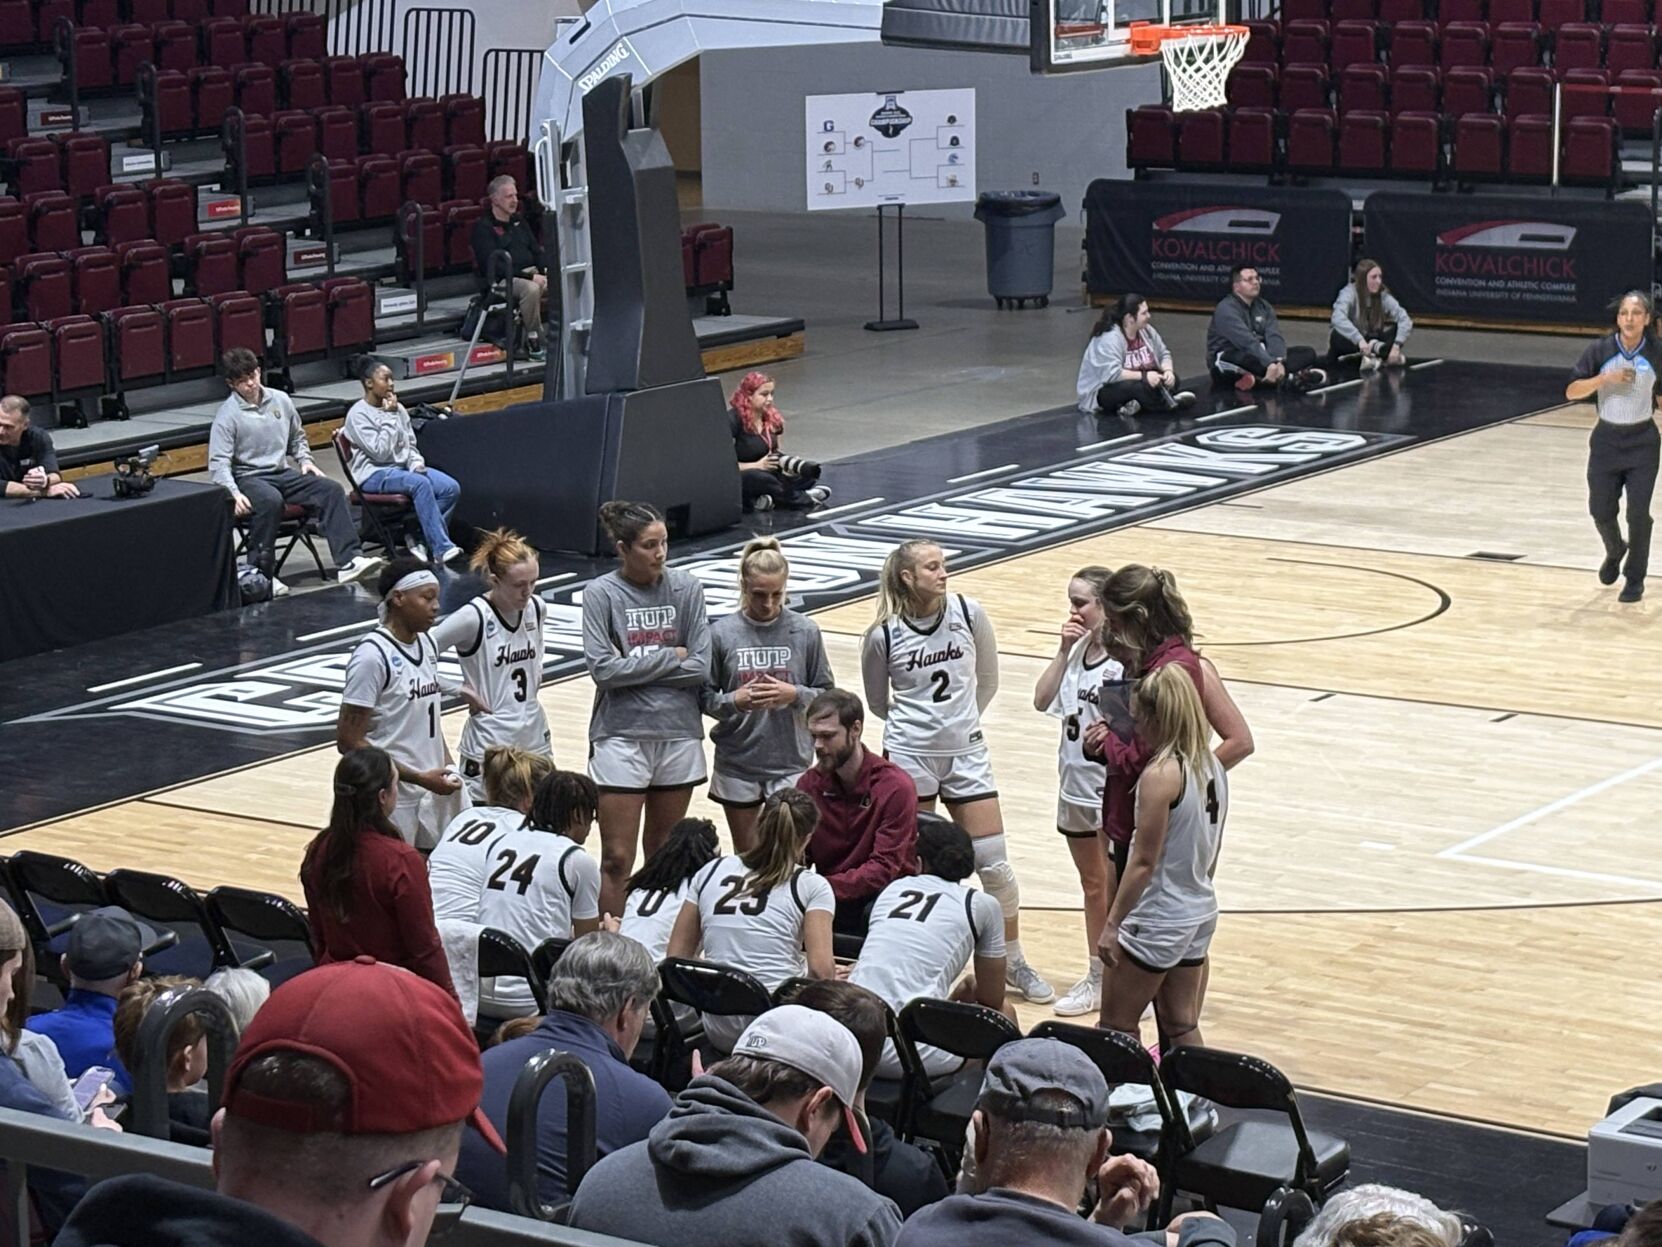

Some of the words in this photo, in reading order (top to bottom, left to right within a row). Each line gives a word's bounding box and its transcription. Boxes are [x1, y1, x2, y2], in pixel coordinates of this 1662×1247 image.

[578, 42, 630, 95] SPALDING
[1152, 238, 1281, 262] KOVALCHICK
[1435, 252, 1577, 278] KOVALCHICK
[1152, 261, 1198, 272] CONVENTION
[1200, 264, 1216, 273] AND
[1434, 276, 1487, 287] CONVENTION
[1488, 279, 1506, 288] AND
[1507, 280, 1539, 290] ATHLETIC
[1540, 282, 1577, 292] COMPLEX
[858, 423, 1369, 542] HAWKS
[625, 605, 677, 631] IUP
[494, 640, 537, 667] Hawks
[736, 646, 792, 671] IUP
[906, 641, 964, 672] Hawks
[511, 667, 528, 703] 3
[930, 669, 952, 703] 2
[427, 701, 435, 739] 1
[1206, 778, 1220, 825] 4
[446, 818, 496, 846] 10
[487, 848, 542, 897] 24
[887, 889, 943, 923] 21
